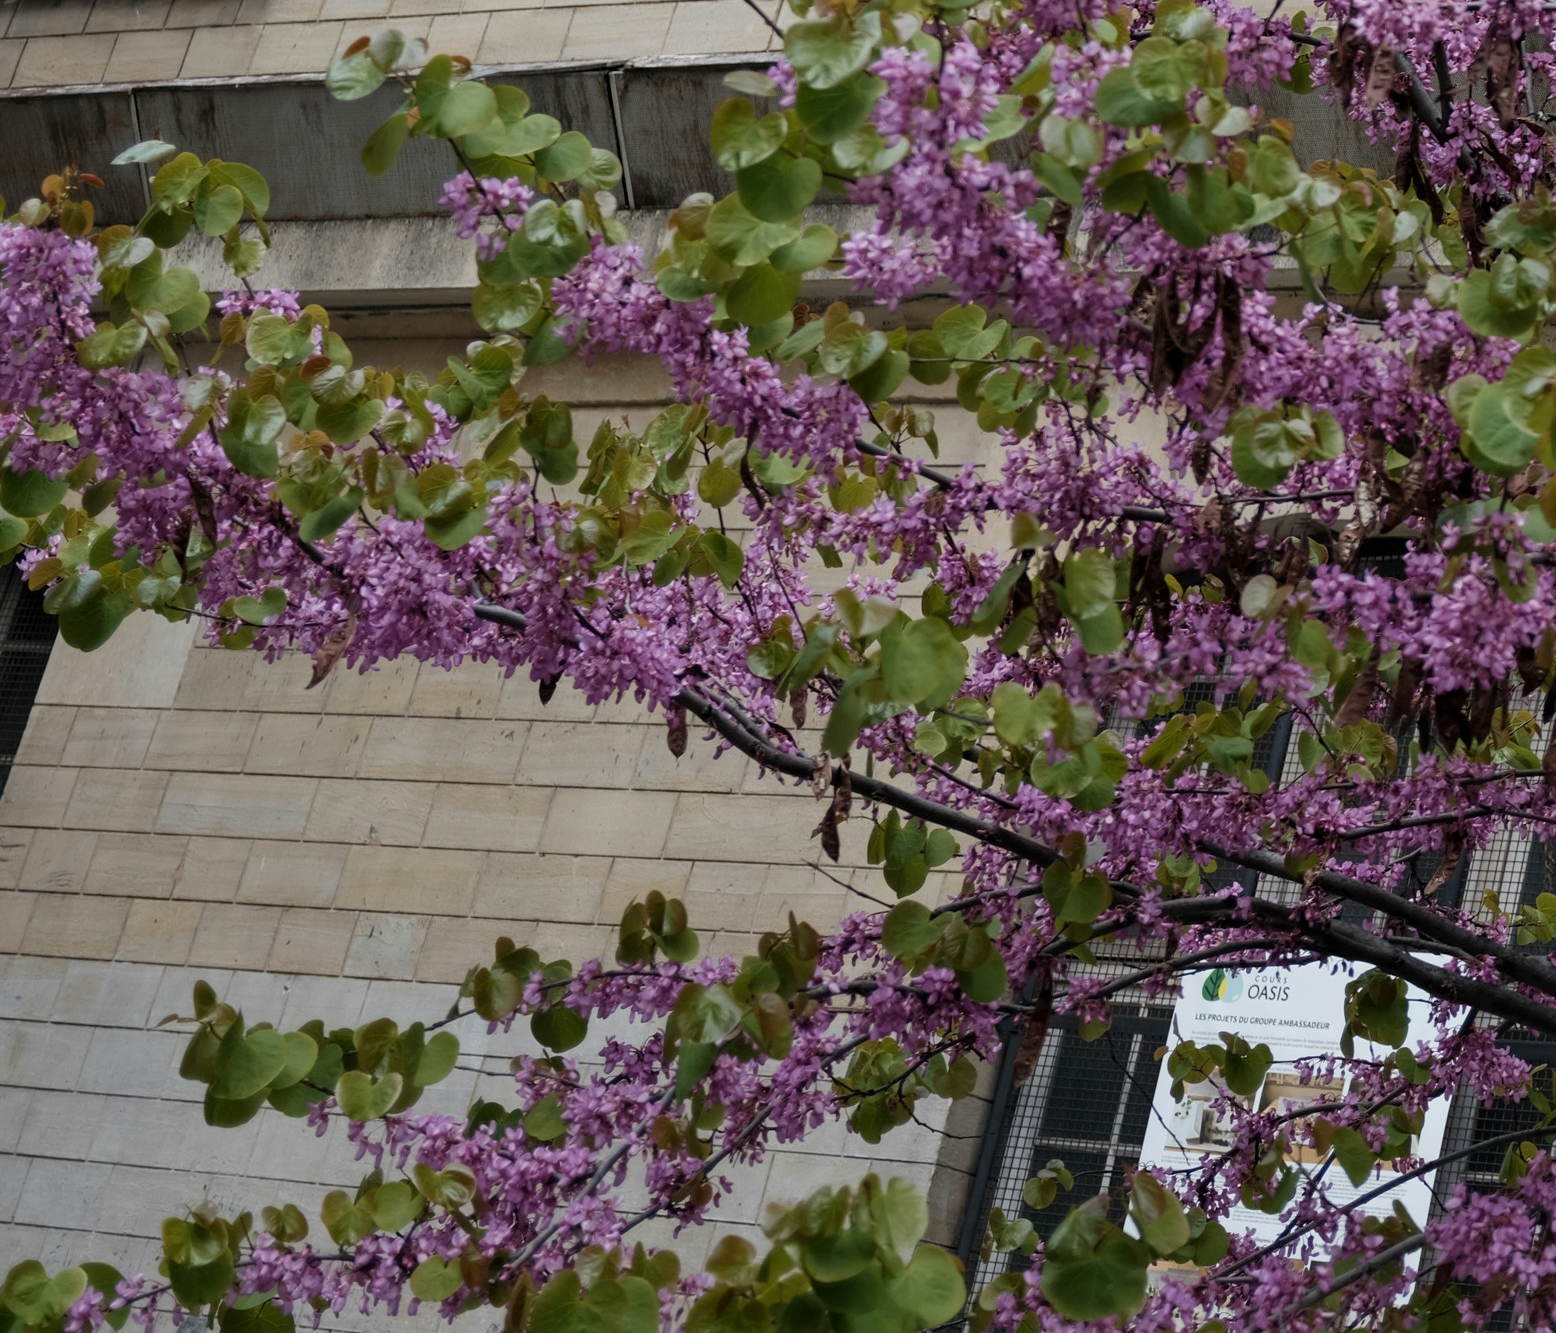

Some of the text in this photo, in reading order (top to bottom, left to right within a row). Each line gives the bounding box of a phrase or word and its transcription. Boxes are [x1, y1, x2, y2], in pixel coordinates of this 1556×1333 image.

[1254, 975, 1288, 984] COURS
[1247, 984, 1290, 1001] OASIS
[1195, 1013, 1330, 1030] LES PROJETS DU GROUPE AMBASSADEUR
